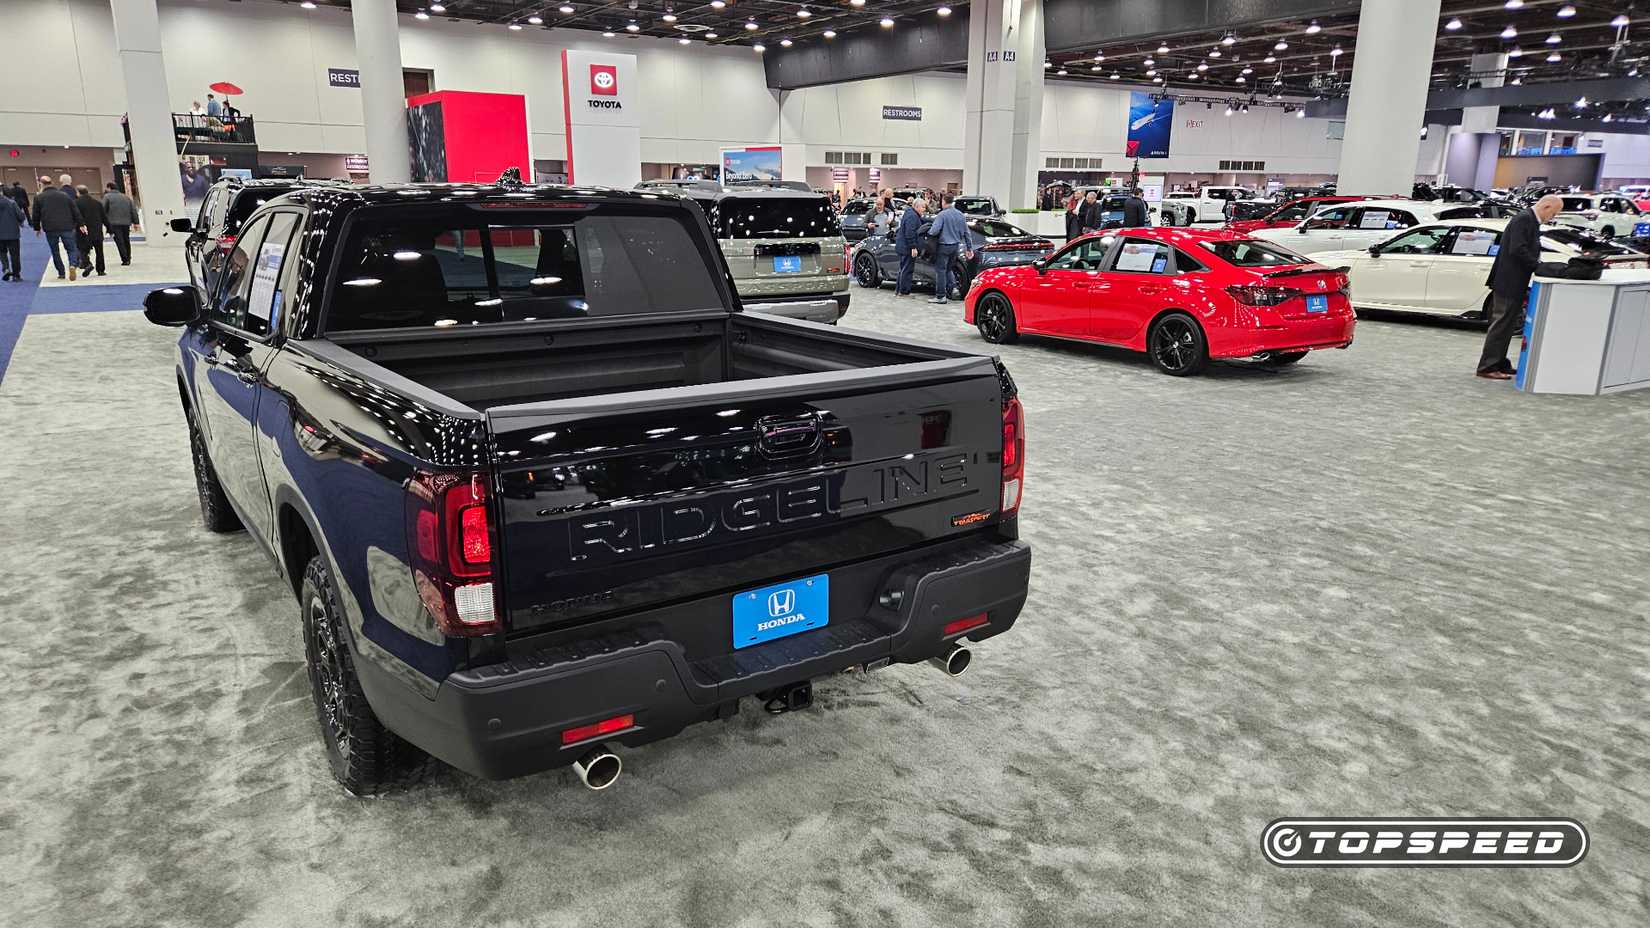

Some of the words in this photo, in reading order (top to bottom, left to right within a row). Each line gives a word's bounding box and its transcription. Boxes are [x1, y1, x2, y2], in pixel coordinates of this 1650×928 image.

[1003, 51, 1015, 61] A4
[587, 100, 622, 109] TOYOTA
[883, 109, 921, 118] RESTROOMS
[568, 452, 968, 562] RIDGELINE
[757, 613, 806, 632] HONDA
